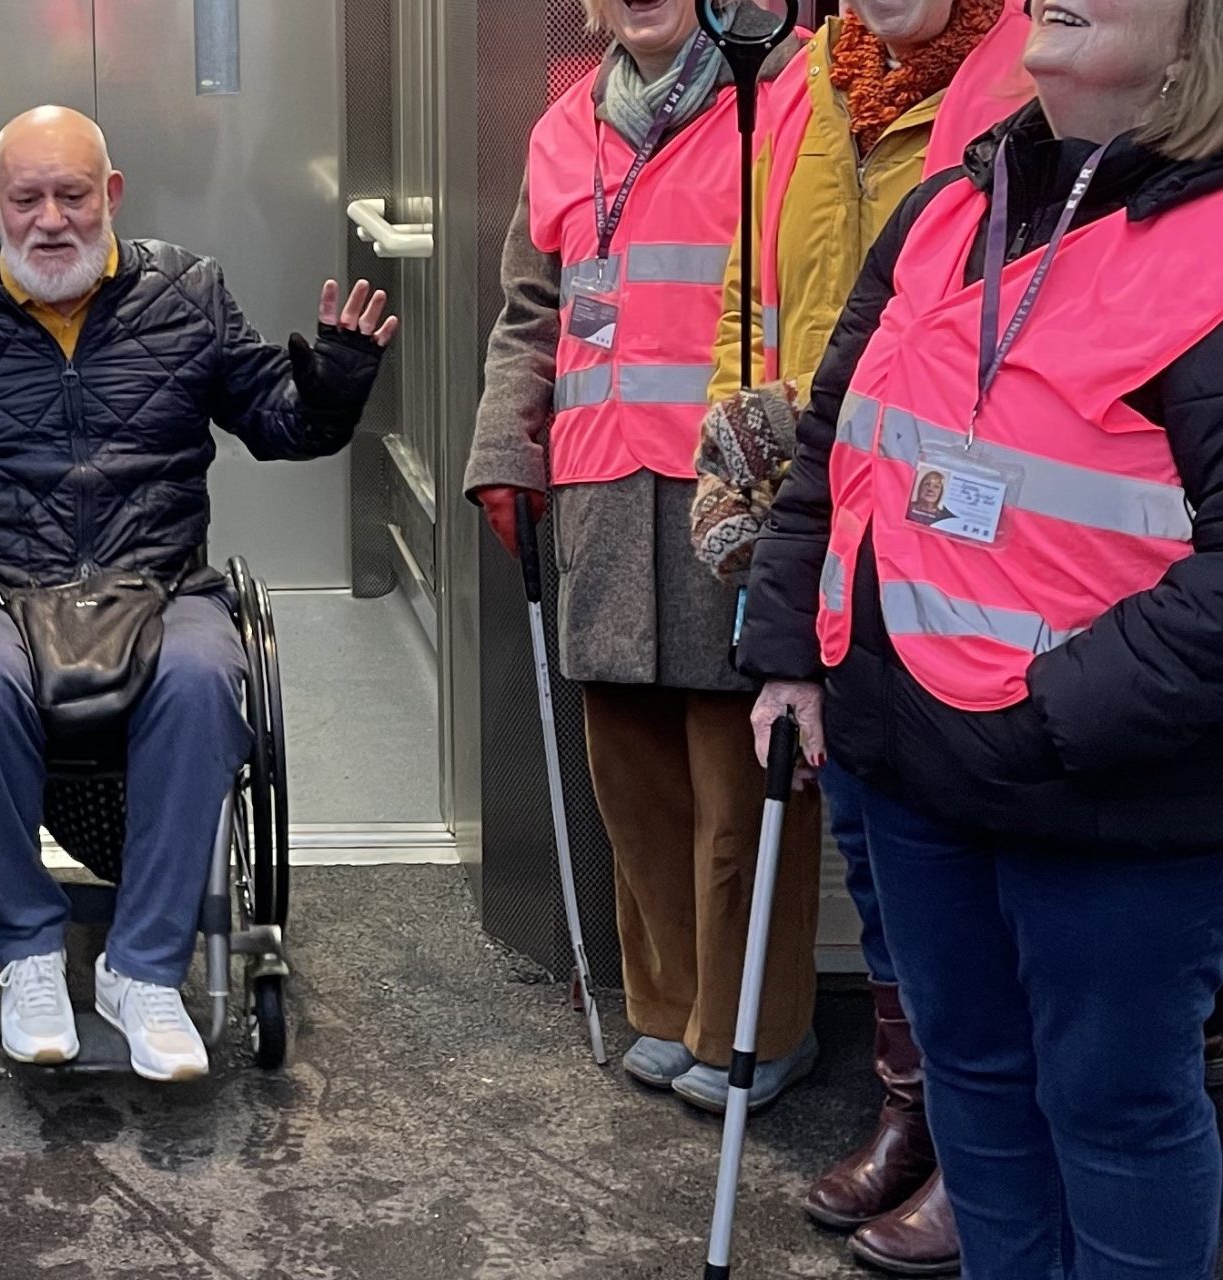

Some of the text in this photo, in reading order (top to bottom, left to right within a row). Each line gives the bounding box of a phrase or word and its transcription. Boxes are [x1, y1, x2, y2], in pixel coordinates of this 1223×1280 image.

[663, 83, 685, 113] EMR
[626, 143, 653, 186] STATION
[985, 168, 1093, 377] MMUNITY RAIL EMR
